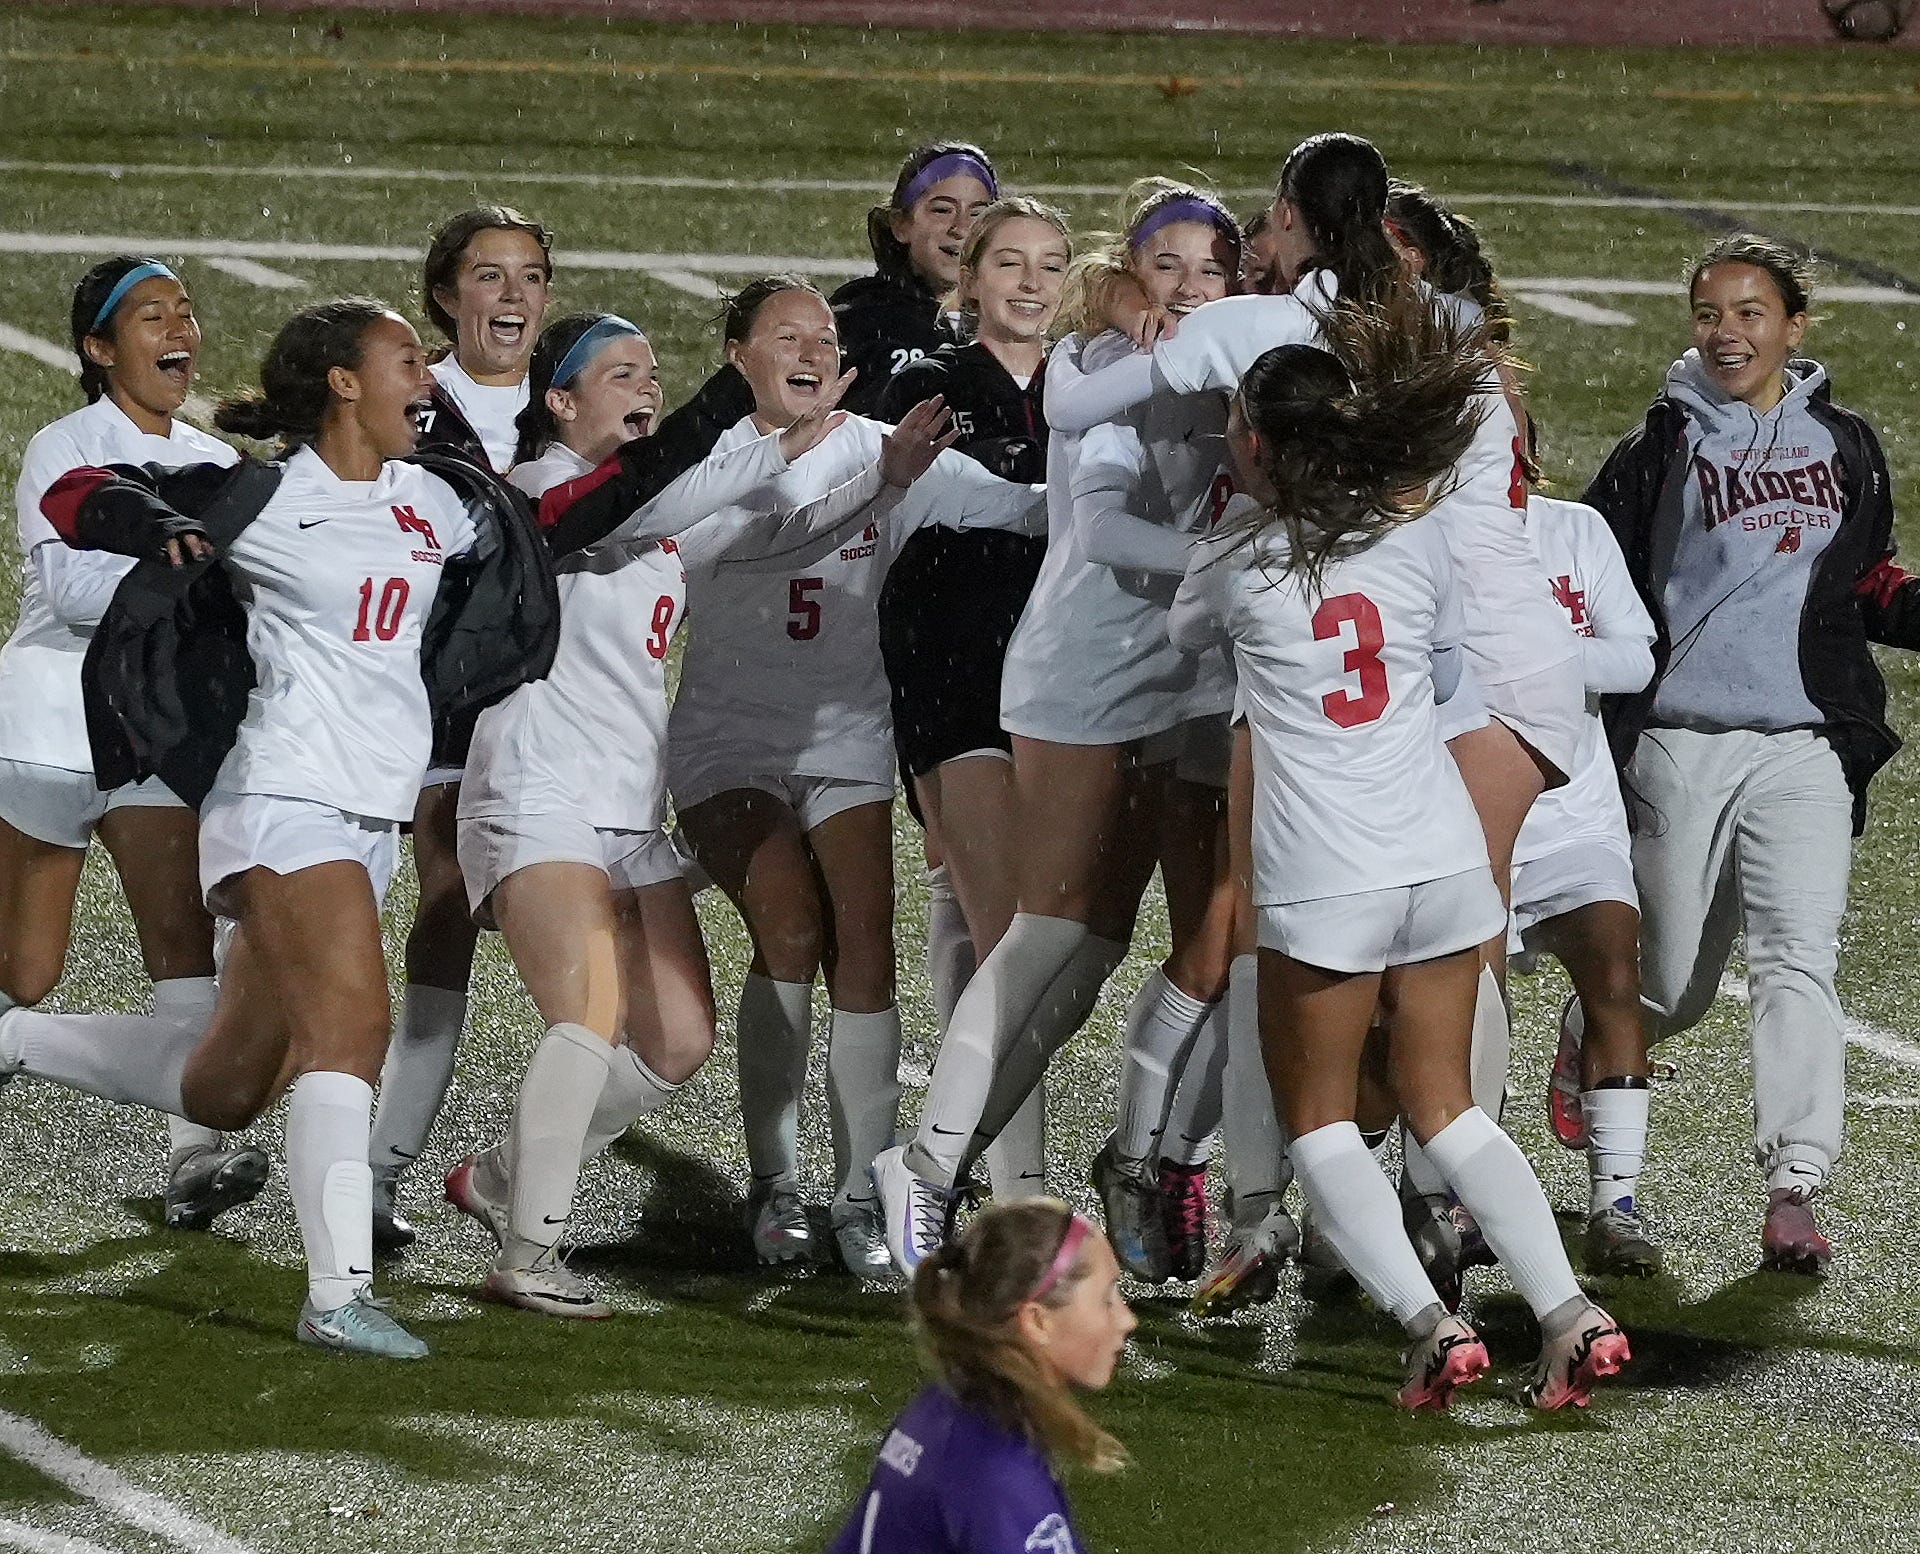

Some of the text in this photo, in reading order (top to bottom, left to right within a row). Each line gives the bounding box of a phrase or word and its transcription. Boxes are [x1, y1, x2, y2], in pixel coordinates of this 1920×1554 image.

[951, 411, 975, 434] 15
[1695, 454, 1849, 532] RAIDERS
[1741, 509, 1831, 531] SOCCER
[390, 505, 442, 549] NR
[353, 577, 410, 641] 10
[647, 595, 675, 660] 9
[787, 577, 824, 641] 5
[1311, 592, 1390, 728] 3
